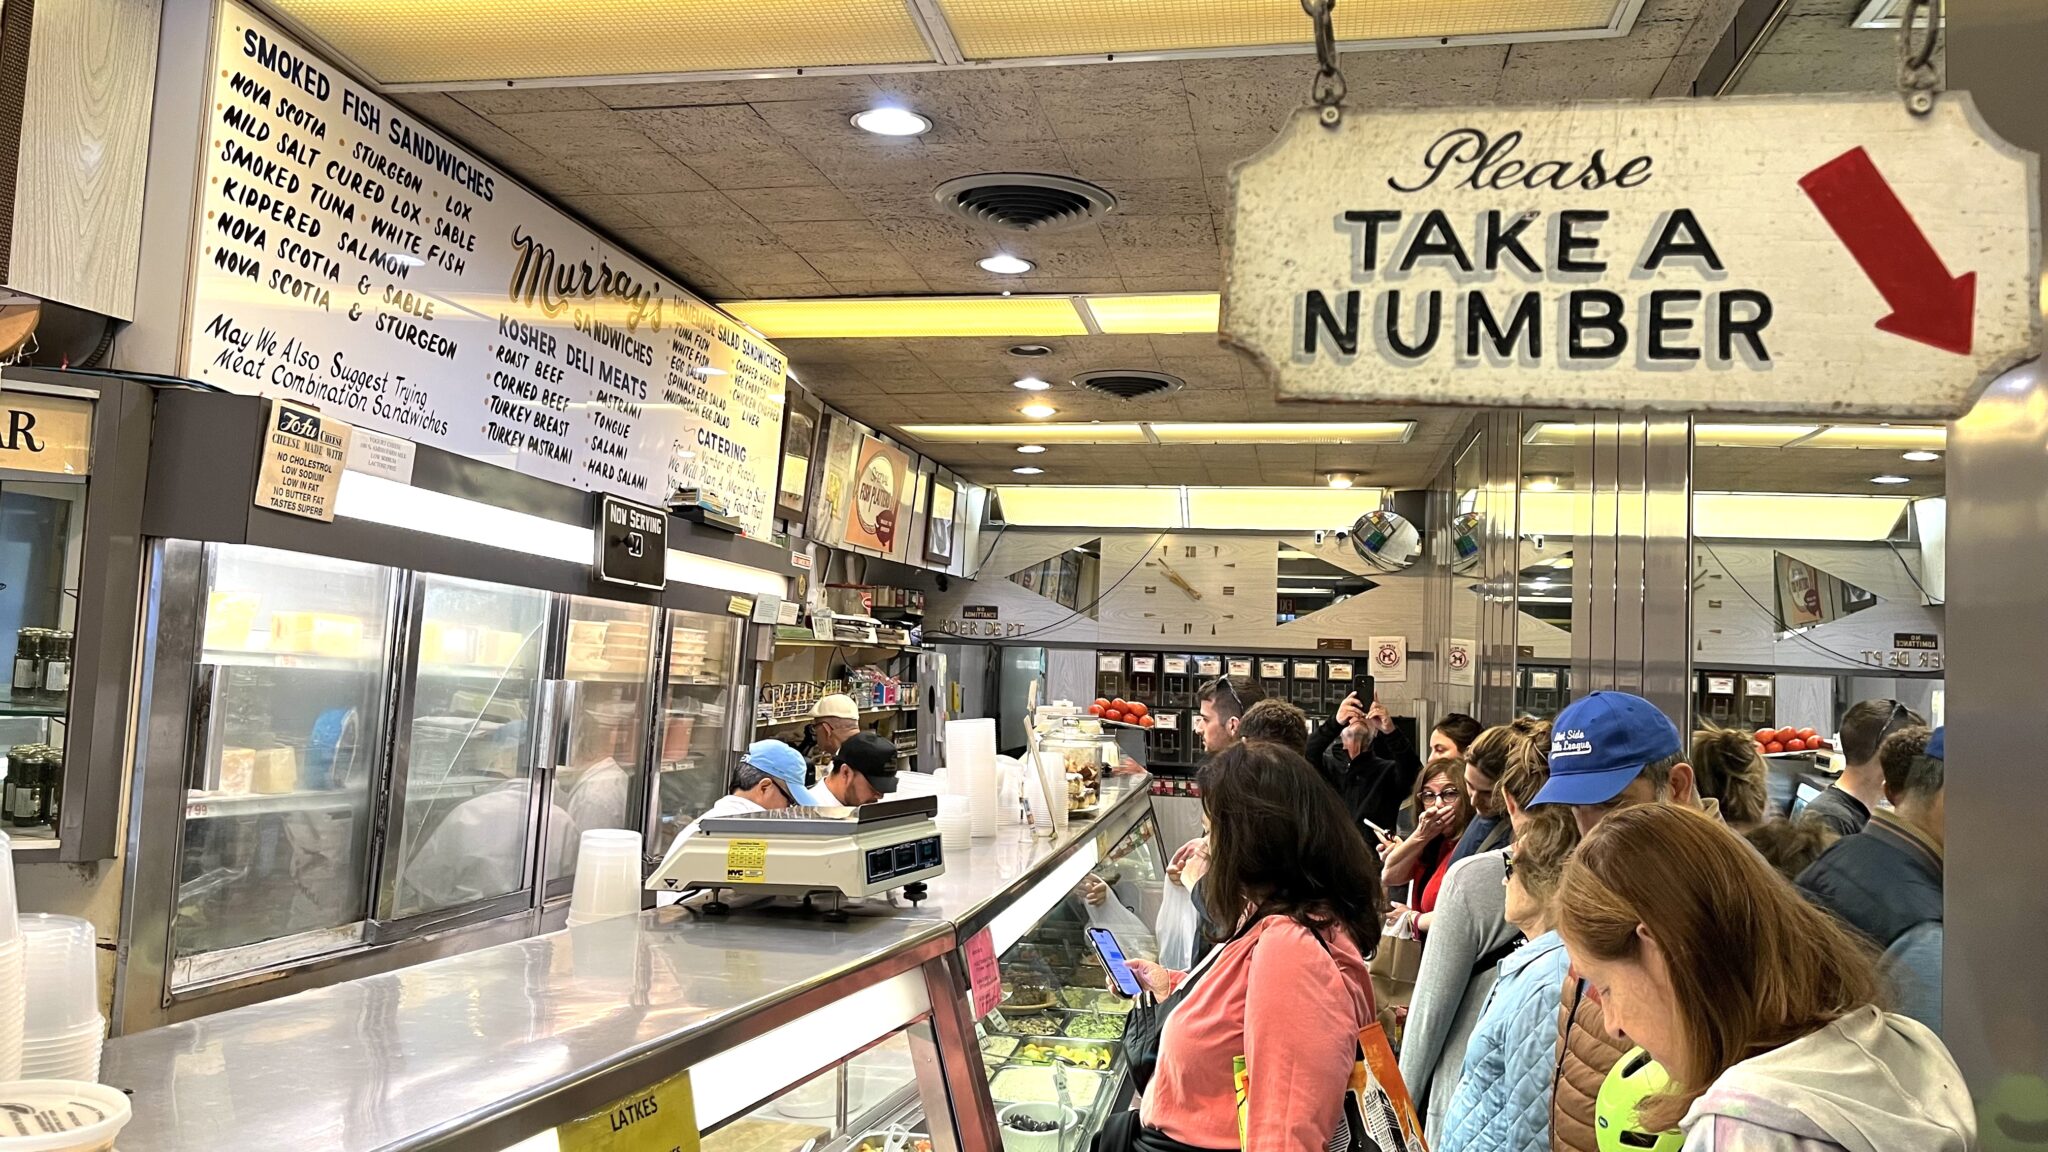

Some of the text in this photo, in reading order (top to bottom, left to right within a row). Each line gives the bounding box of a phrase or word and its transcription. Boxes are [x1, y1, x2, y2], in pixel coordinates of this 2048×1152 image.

[243, 29, 494, 201] SMOKED FISH SANDWICHES
[231, 72, 472, 221] NOVA SCOTIA STURGEON LOX
[1388, 126, 1654, 195] Please
[224, 105, 476, 252] MILD SALT CURED LOX SABLE
[222, 139, 465, 276] SMOKED TUNA WHITE FISH
[223, 177, 410, 280] KIPPERED SALMON
[1336, 207, 1727, 281] TAKE A
[218, 212, 434, 320] NOVA SCOTIA & SABLE
[510, 225, 663, 333] Murray's
[215, 246, 457, 360] NOVA SCOTIA & STURGEON
[574, 309, 653, 366] SANDWICHES
[674, 294, 782, 375] HOMEMADE SALAD SANDWICHES
[675, 322, 710, 352] TUNA FISH
[1295, 289, 1773, 368] NUMBER
[205, 314, 427, 410] May We Also Suggest Trying
[496, 345, 564, 384] ROAST BEEF
[499, 313, 647, 400] KOSHER DELI MEATS
[671, 356, 707, 384] EGG SALAD
[672, 339, 709, 367] WHITE FISH
[214, 348, 448, 435] Meat Combination Sandwiches
[494, 371, 570, 412] CORNED BEEF
[596, 390, 642, 419] PASTRAMI
[668, 372, 726, 411] SPINACH EGG SALAD
[280, 411, 318, 438] Tofu
[490, 395, 569, 437] TURKEY BREAST
[595, 412, 630, 438] TONGUE
[701, 405, 712, 421] EGG
[713, 412, 730, 428] SALAD
[742, 411, 759, 427] LIVER
[272, 433, 343, 461] CHEESE MADE WITH
[488, 422, 572, 464] TURKEY PASTRAMI
[591, 436, 627, 460] SALAMI
[698, 428, 746, 462] CATERING
[277, 452, 332, 474] NO CHOLESTROL
[282, 465, 324, 482] LOW SODIUM
[588, 459, 648, 490] HARD SALAMI
[668, 456, 680, 473] We
[682, 460, 698, 480] Will
[699, 466, 716, 486] Plan
[274, 486, 324, 505] NO BUTTER FAT
[283, 477, 319, 493] LOW IN FAT
[271, 497, 323, 516] TASTES SUPERB
[610, 504, 662, 535] NOW SERVING
[734, 498, 749, 515] Food
[752, 504, 763, 520] That
[1567, 730, 1584, 740] Side
[610, 1095, 658, 1132] LATKES
